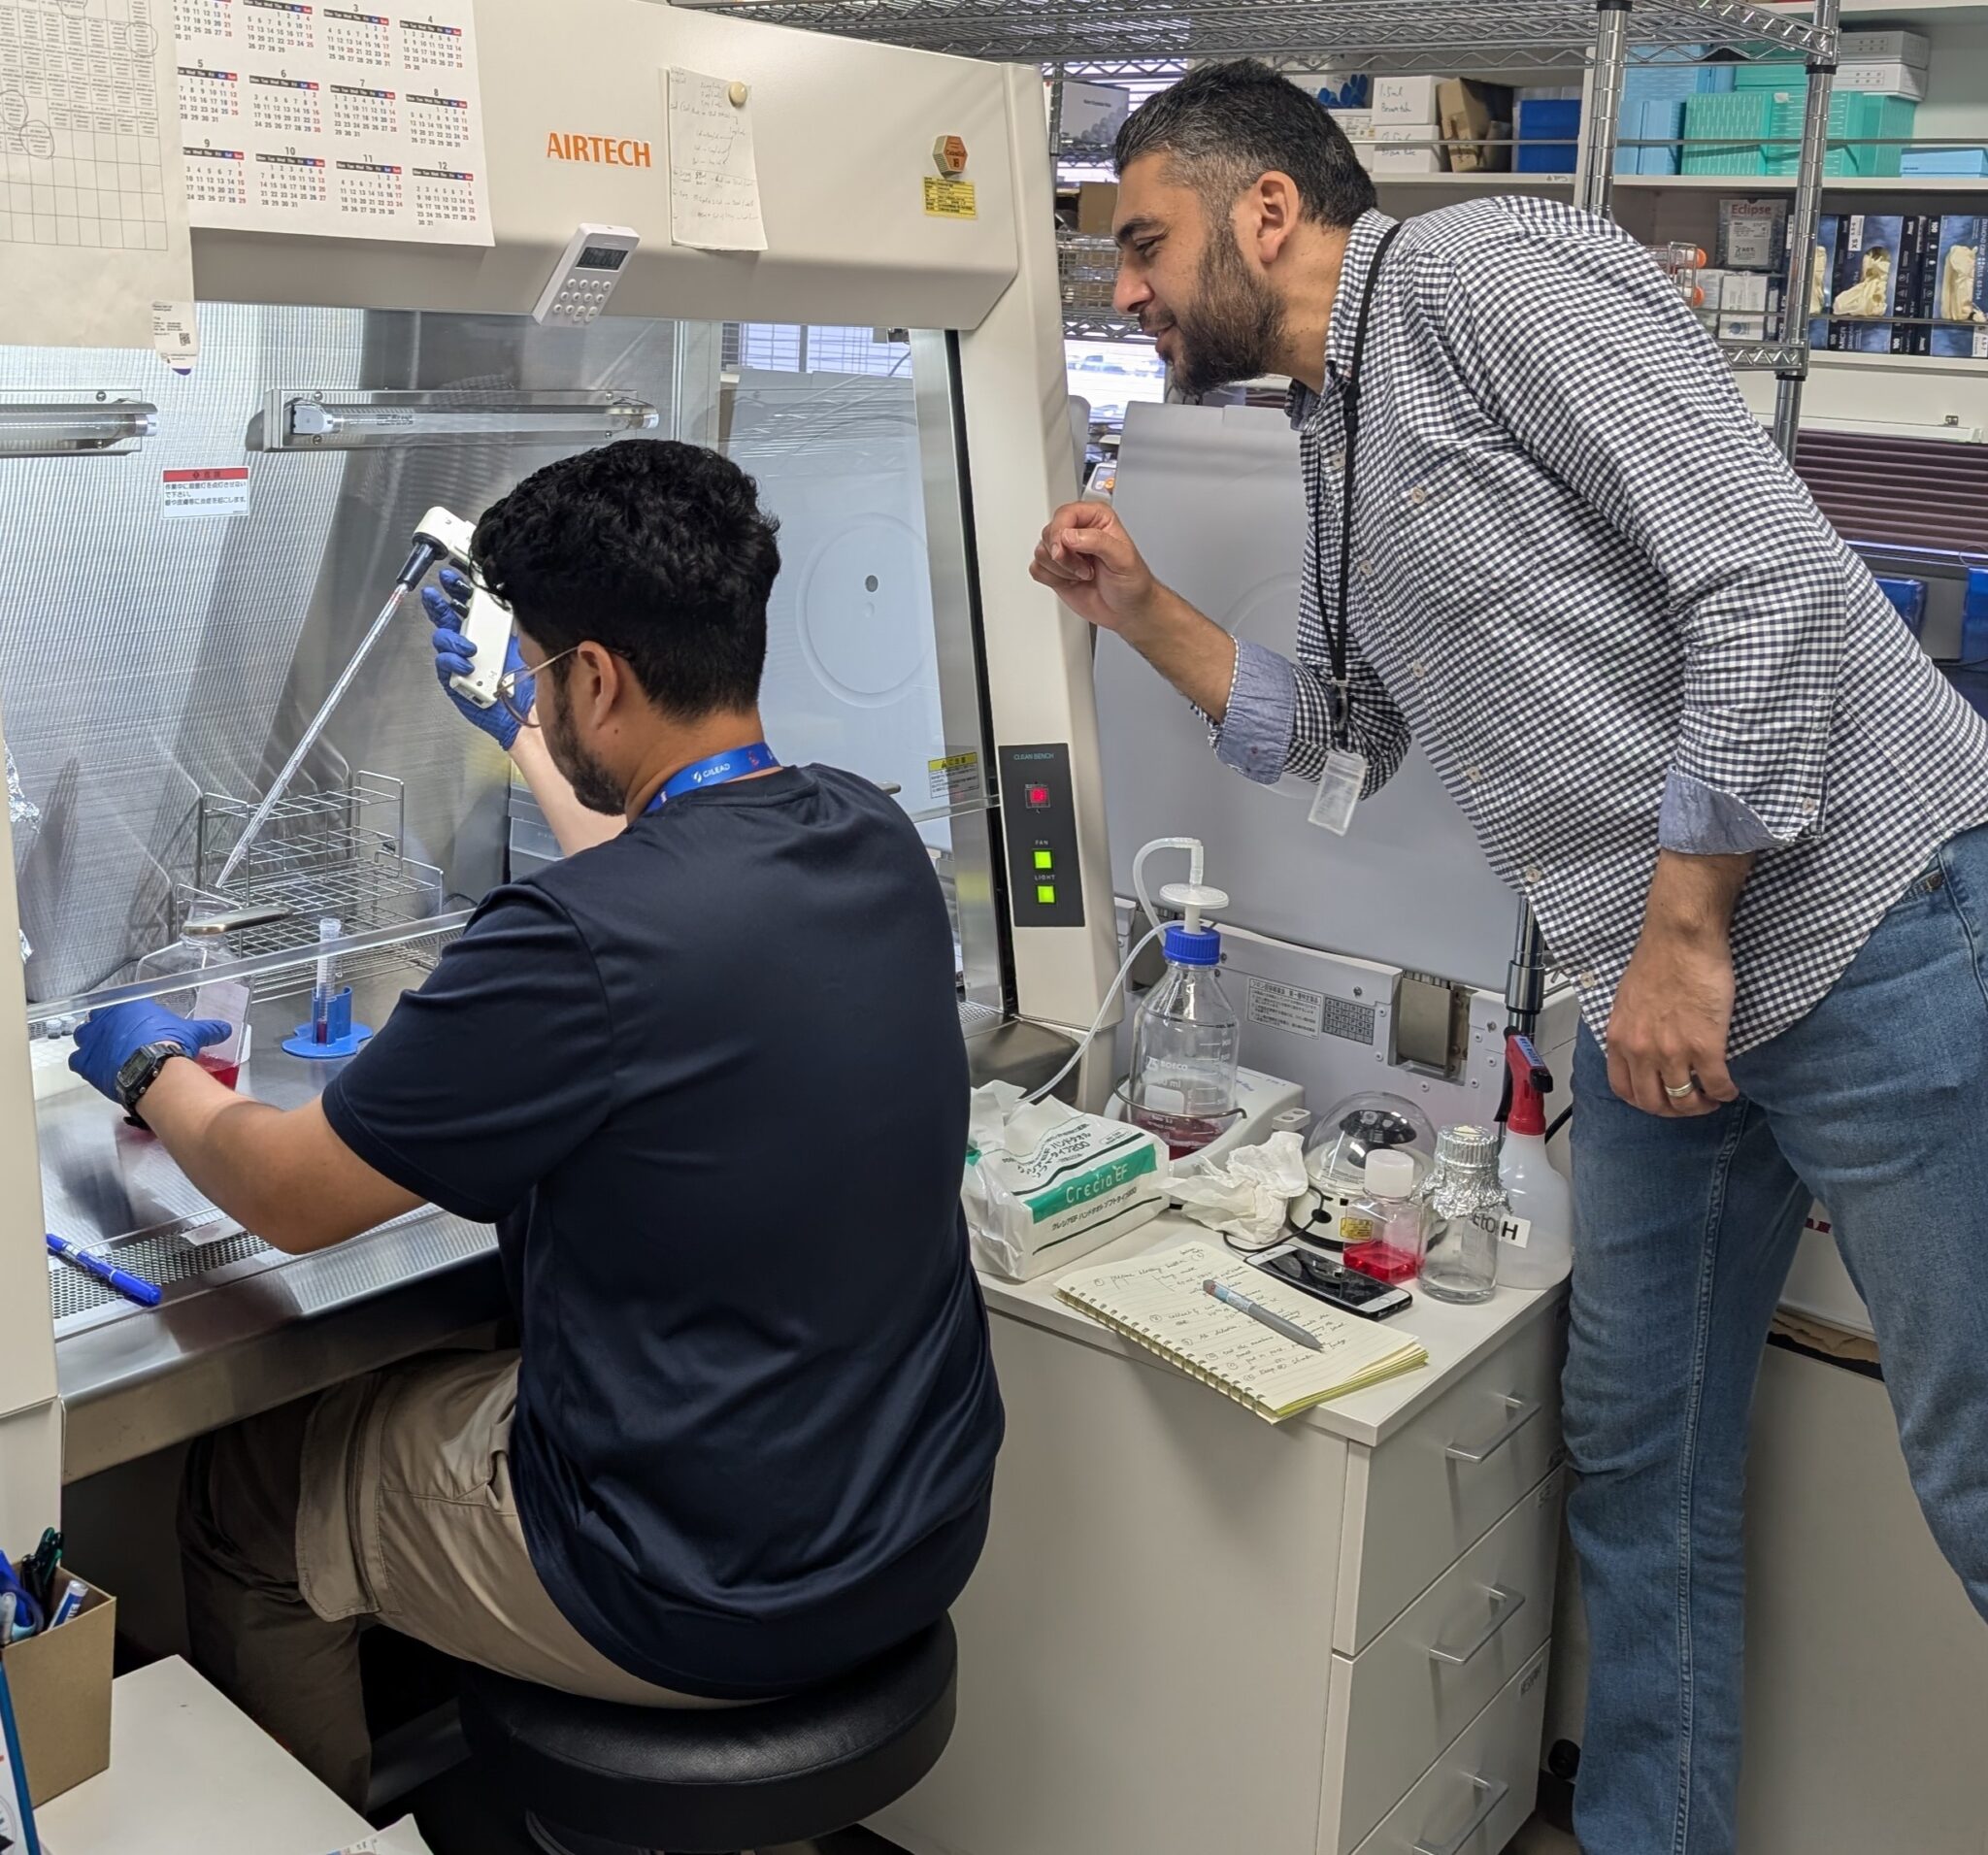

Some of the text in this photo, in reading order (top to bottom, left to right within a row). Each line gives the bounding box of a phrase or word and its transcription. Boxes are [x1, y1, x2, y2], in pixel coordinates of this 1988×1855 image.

[197, 59, 204, 68] 5
[359, 79, 365, 87] 7
[204, 139, 211, 148] 9
[284, 147, 295, 155] 10
[547, 132, 651, 167] AIRTECH
[1732, 204, 1772, 216] Eclipse
[1851, 239, 1858, 248] XS
[702, 763, 731, 778] GILEAD
[1066, 1164, 1128, 1204] Crecia EF
